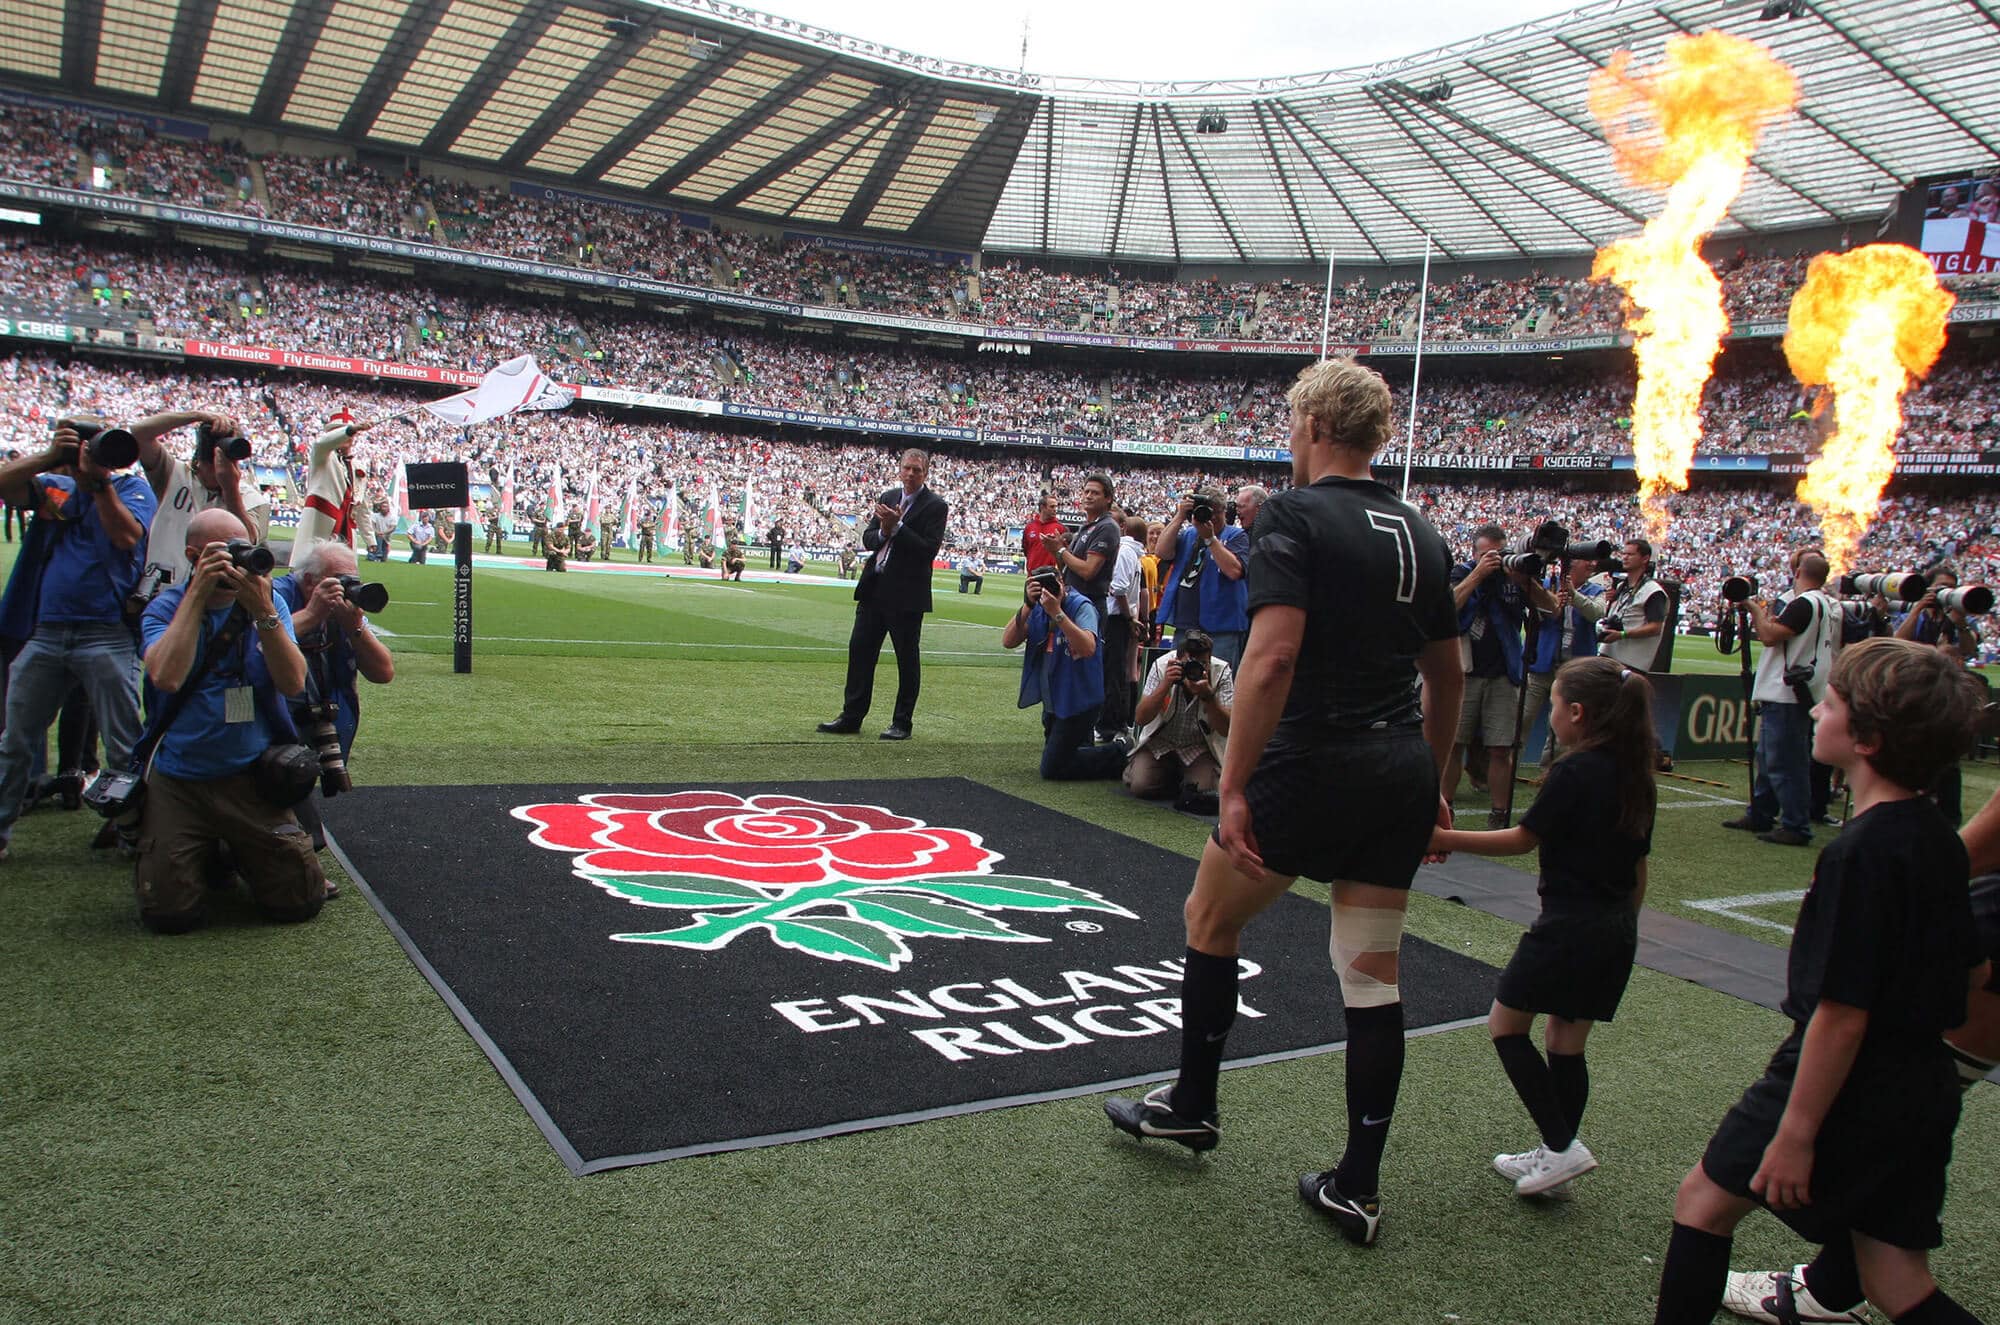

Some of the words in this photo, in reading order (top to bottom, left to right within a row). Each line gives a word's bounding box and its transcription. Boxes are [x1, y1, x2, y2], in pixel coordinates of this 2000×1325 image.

[38, 190, 75, 202] BRING
[79, 196, 90, 205] IT
[94, 198, 109, 208] TO
[113, 201, 137, 212] LIFE
[181, 212, 207, 223] LAND
[208, 216, 240, 228] ROVER
[261, 224, 286, 235] LAND
[286, 228, 316, 239] ROVER
[337, 235, 360, 245] LAND
[413, 247, 435, 257] LAND
[436, 251, 464, 261] ROVER
[482, 258, 503, 268] LAND
[503, 261, 530, 272] ROVER
[1929, 254, 2000, 273] NGLAN
[547, 268, 568, 278] LAND
[569, 271, 594, 282] ROVER
[17, 320, 67, 337] CBRE
[985, 328, 1029, 340] LifeSkills
[1130, 338, 1174, 350] LifeSkills
[1231, 344, 1314, 354] www.antler.co.uk
[1372, 344, 1433, 354] EURONIS
[1436, 342, 1500, 352] EURONICS
[1504, 341, 1568, 352] EURONICS
[199, 342, 219, 357] Fly
[220, 346, 271, 361] Emirates
[283, 352, 303, 366] Fly
[304, 355, 352, 370] Emirates
[363, 362, 382, 375] Fly
[383, 365, 429, 378] Emirates
[440, 370, 457, 383] Fly
[741, 407, 760, 417] LAND
[761, 410, 784, 419] ROVER
[798, 413, 817, 422] LAND
[819, 416, 842, 425] ROVER
[858, 421, 878, 430] LAND
[878, 423, 903, 432] ROVER
[918, 427, 937, 435] LAND
[938, 429, 961, 437] ROVER
[983, 431, 1007, 442] Eden
[1020, 434, 1044, 445] Park
[1050, 436, 1074, 447] Eden
[1087, 439, 1111, 450] Park
[1128, 442, 1177, 454] BASILDON
[1178, 445, 1230, 457] CHEMICALS
[1249, 448, 1277, 460] BAXI
[1439, 454, 1512, 468] BARTLETT
[1896, 453, 1914, 463] NTO
[1916, 453, 1949, 464] SEATED
[1949, 453, 1980, 464] AREAS
[1903, 464, 1931, 474] CARRY
[1932, 464, 1946, 474] UP
[1946, 464, 1958, 474] TO
[1959, 464, 1966, 473] 4
[1967, 464, 1993, 474] PINTS
[1365, 509, 1417, 603] 7
